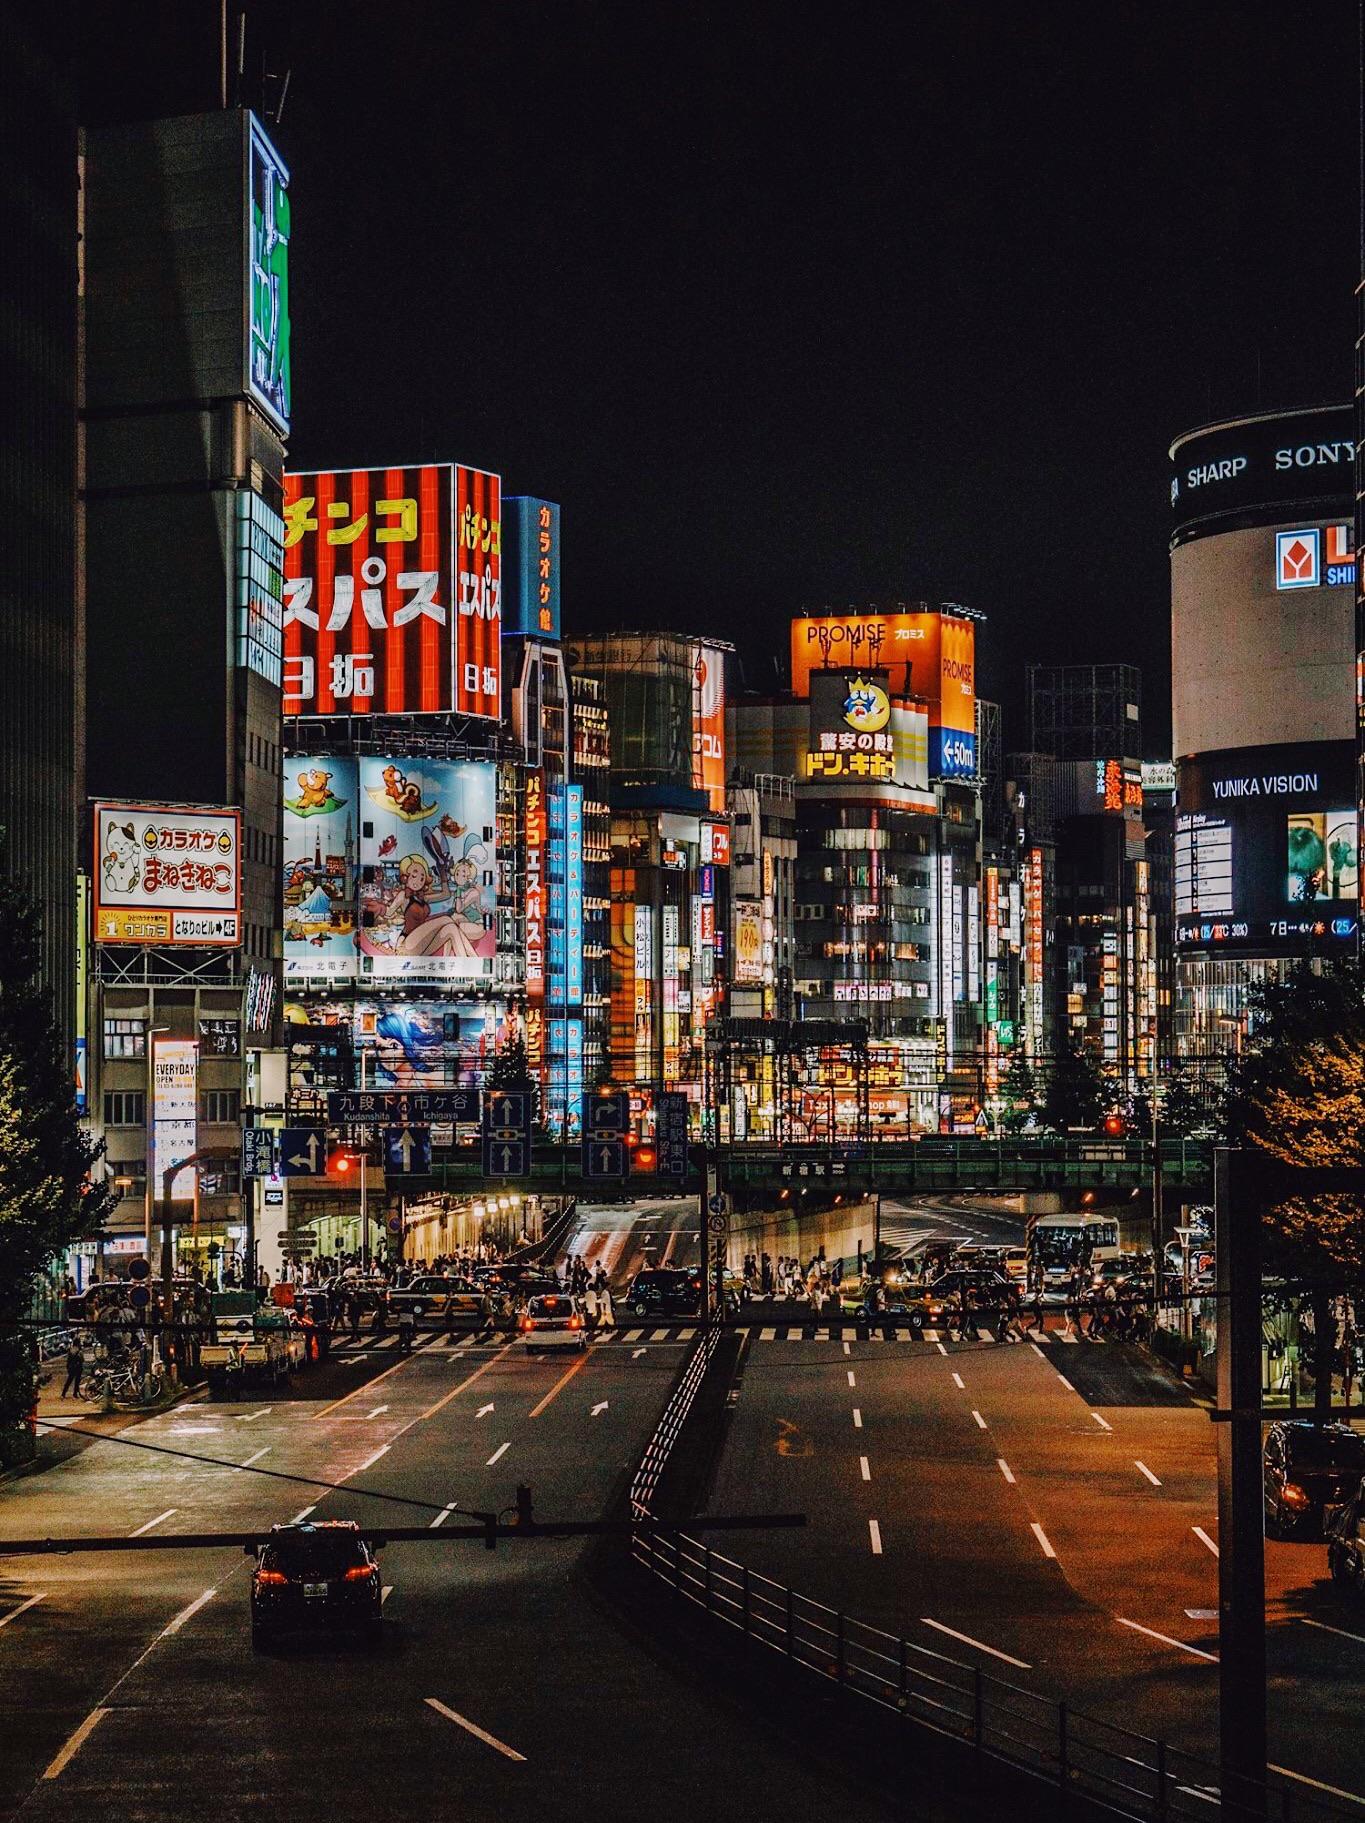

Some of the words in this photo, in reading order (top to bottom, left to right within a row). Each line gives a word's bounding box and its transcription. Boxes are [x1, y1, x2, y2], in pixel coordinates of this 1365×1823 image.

[1187, 457, 1247, 488] SHARP
[460, 503, 500, 556] パチンコ
[538, 506, 553, 636] カラオケ館
[808, 624, 886, 643] PROMISE
[895, 629, 926, 640] プロミス
[284, 653, 375, 700] 日拓
[465, 662, 497, 696] 日拓
[943, 658, 972, 683] PROMISE
[954, 741, 974, 770] 50m
[1212, 778, 1260, 799] YUNIKA
[1262, 774, 1318, 795] VISION
[160, 827, 217, 852] カラオケ
[143, 857, 232, 895] まねきねこ
[124, 924, 167, 937] ワンカラ
[175, 920, 215, 936] となりのビル
[224, 920, 236, 936] 4F
[156, 1064, 195, 1075] EVERYDAY
[339, 1095, 395, 1111] 九段下
[344, 1112, 390, 1121] Kudanshita
[423, 1111, 459, 1122] Ichigaya
[245, 1131, 254, 1152] Otaki
[670, 1096, 683, 1173] 新宿駅東口
[255, 1131, 271, 1174] 小滝橋
